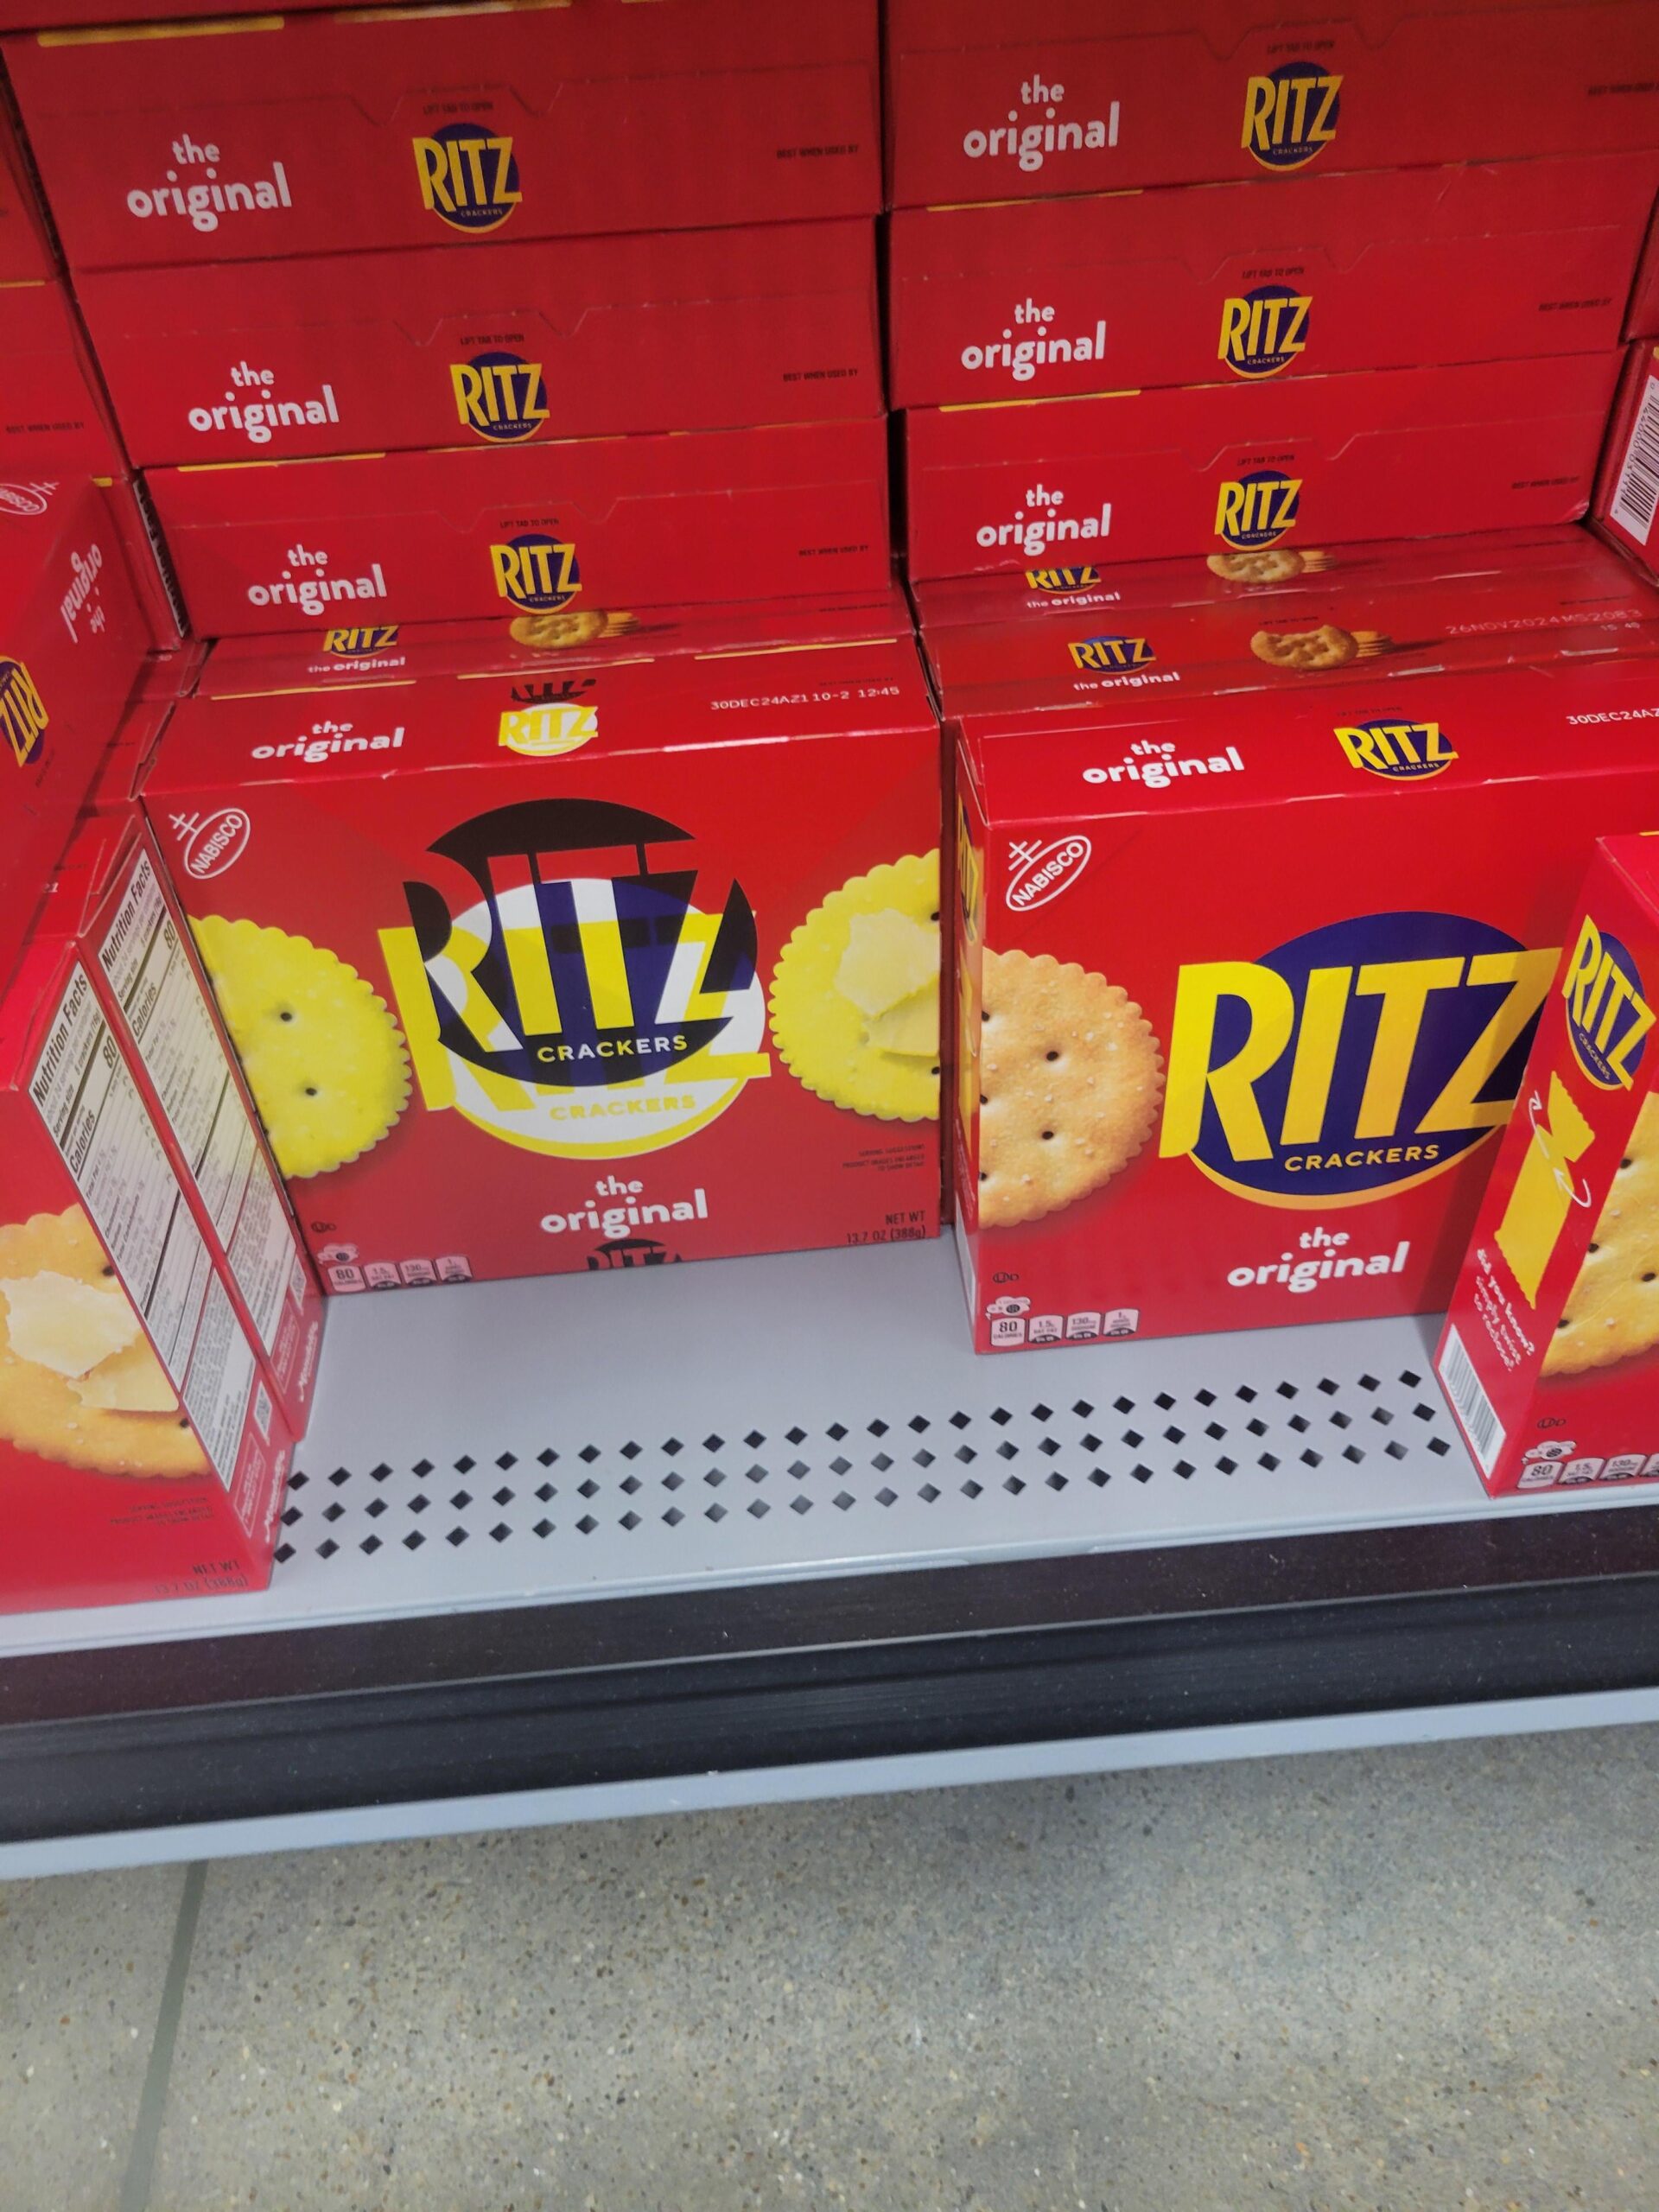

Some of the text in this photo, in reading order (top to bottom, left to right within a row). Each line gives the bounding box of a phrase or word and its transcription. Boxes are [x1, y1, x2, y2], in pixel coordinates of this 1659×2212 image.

[1021, 74, 1065, 105] the
[1241, 75, 1344, 151] RITZ
[172, 134, 219, 165] the
[963, 101, 1120, 171] original
[127, 162, 291, 232] original
[412, 137, 523, 213] RITZ
[1014, 298, 1055, 324] the
[1217, 296, 1313, 361] RITZ
[962, 321, 1106, 381] original
[231, 361, 274, 388] the
[450, 363, 550, 426] RITZ
[188, 385, 339, 443] original
[1026, 484, 1064, 507] the
[1214, 479, 1303, 536] RITZ
[976, 504, 1111, 556] original
[288, 544, 327, 568] the
[490, 543, 582, 599] RITZ
[1026, 567, 1102, 589] RITZ
[60, 544, 102, 643] original
[248, 564, 387, 615] original
[1027, 591, 1122, 609] the original
[323, 625, 399, 652] RITZ
[1068, 638, 1157, 669] RITZ
[308, 655, 406, 674] the original
[1073, 671, 1181, 692] the original
[251, 727, 405, 763] original
[312, 721, 353, 735] the
[499, 706, 599, 747] RITZ
[1131, 740, 1176, 756] the
[1333, 722, 1459, 770] RITZ
[1083, 747, 1245, 788] original
[191, 812, 244, 874] NABISCO
[1012, 841, 1085, 907] NABISCO
[101, 904, 136, 973] Nutrition
[130, 860, 151, 907] Facts
[131, 982, 157, 1038] Calories
[162, 919, 176, 950] 80
[378, 845, 772, 1111] RITZ
[1561, 914, 1656, 1091] RITZ
[33, 973, 87, 1107] Nutrition Facts
[537, 1034, 689, 1064] CRACKERS
[1159, 947, 1563, 1162] RITZ
[1579, 1033, 1611, 1080] CRACKERS
[69, 1109, 96, 1174] Calories
[102, 1035, 118, 1069] 80
[550, 1094, 696, 1121] CRACKERS
[1284, 1143, 1440, 1173] CRACKERS
[595, 1175, 644, 1197] the
[541, 1189, 709, 1239] original
[885, 1211, 925, 1225] NET WT
[1300, 1227, 1351, 1248] the
[335, 1268, 355, 1281] 80
[1227, 1242, 1410, 1293] original
[998, 1321, 1018, 1333] 80
[1530, 1465, 1554, 1477] 80
